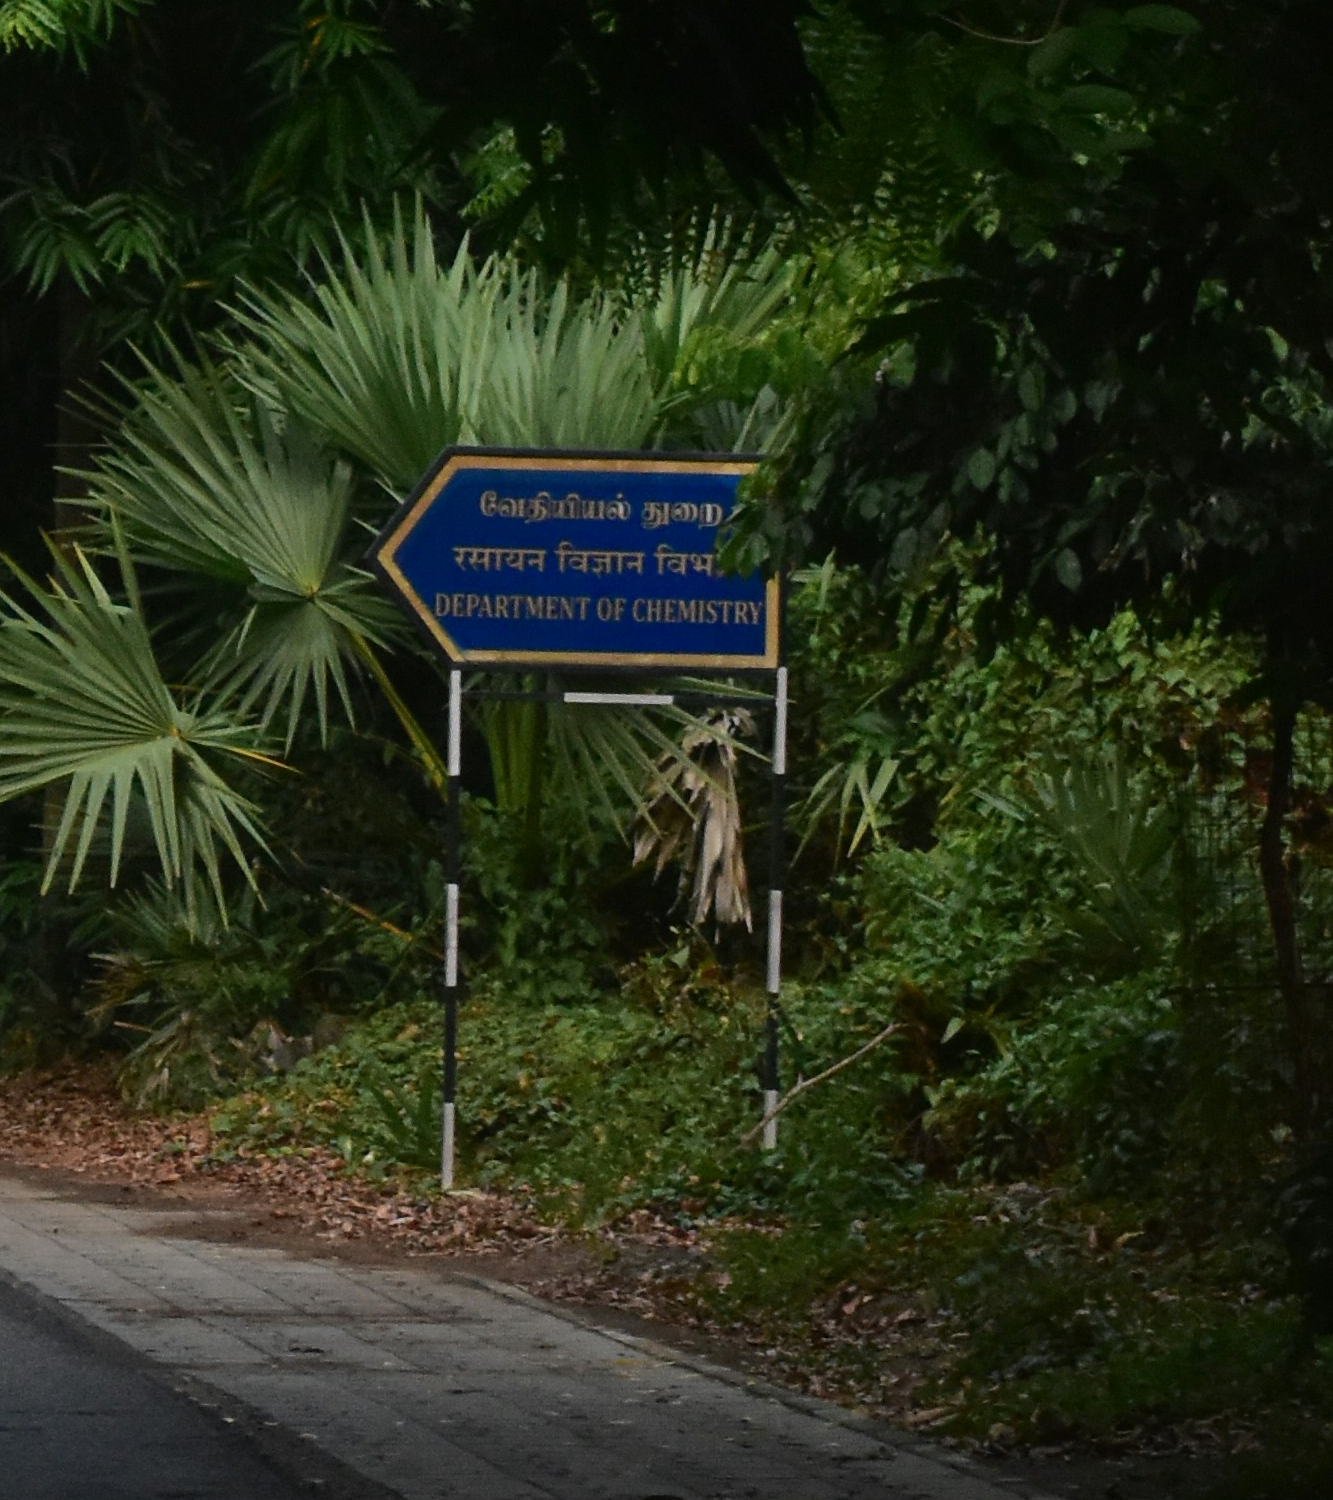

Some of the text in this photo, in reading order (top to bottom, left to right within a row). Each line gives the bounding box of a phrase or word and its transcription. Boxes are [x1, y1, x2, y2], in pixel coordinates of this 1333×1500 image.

[479, 489, 724, 529] வேதியியல் துறை
[452, 541, 724, 578] रसायन विज्ञान विभ
[435, 592, 763, 625] DEPARTMENT OF CHEMISTRY
